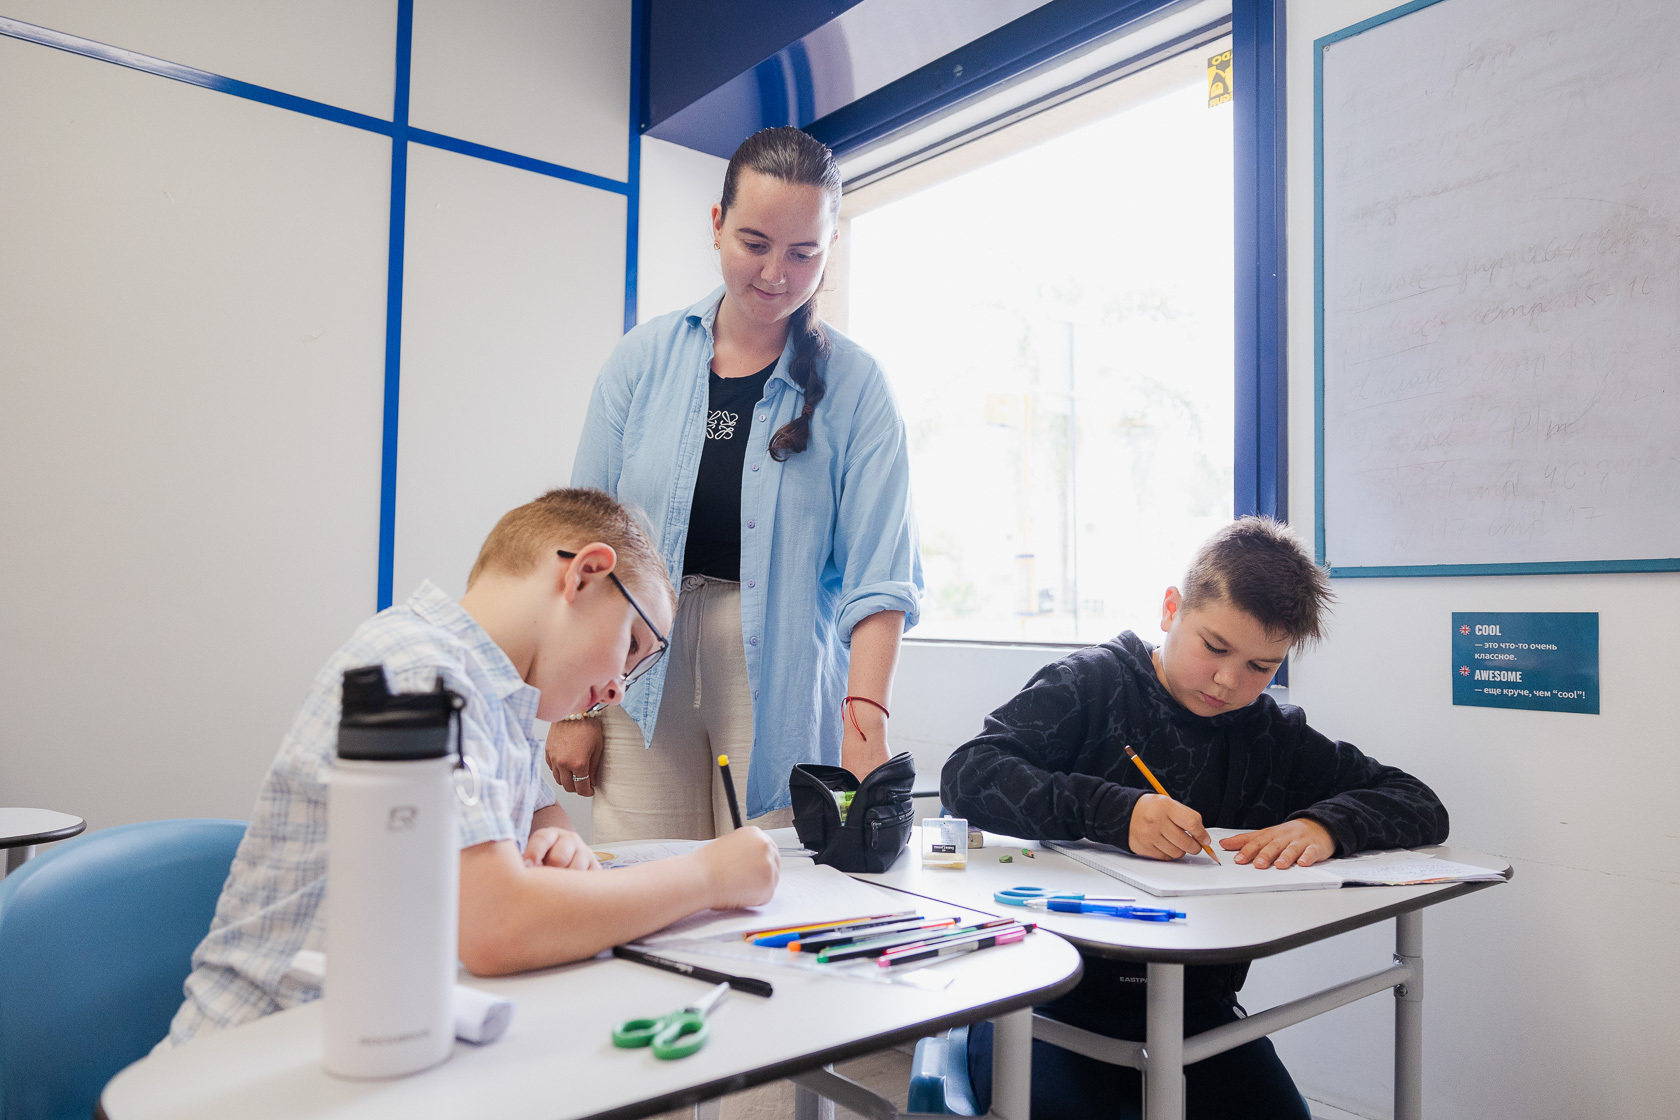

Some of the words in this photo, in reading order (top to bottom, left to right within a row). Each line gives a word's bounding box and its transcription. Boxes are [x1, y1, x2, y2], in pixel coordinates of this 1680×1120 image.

[1475, 624, 1502, 636] COOL
[1530, 643, 1557, 651] очень
[1474, 652, 1517, 661] классное.
[1474, 669, 1523, 683] AWESOME
[1484, 687, 1502, 696] еще
[1503, 688, 1532, 698] круче,
